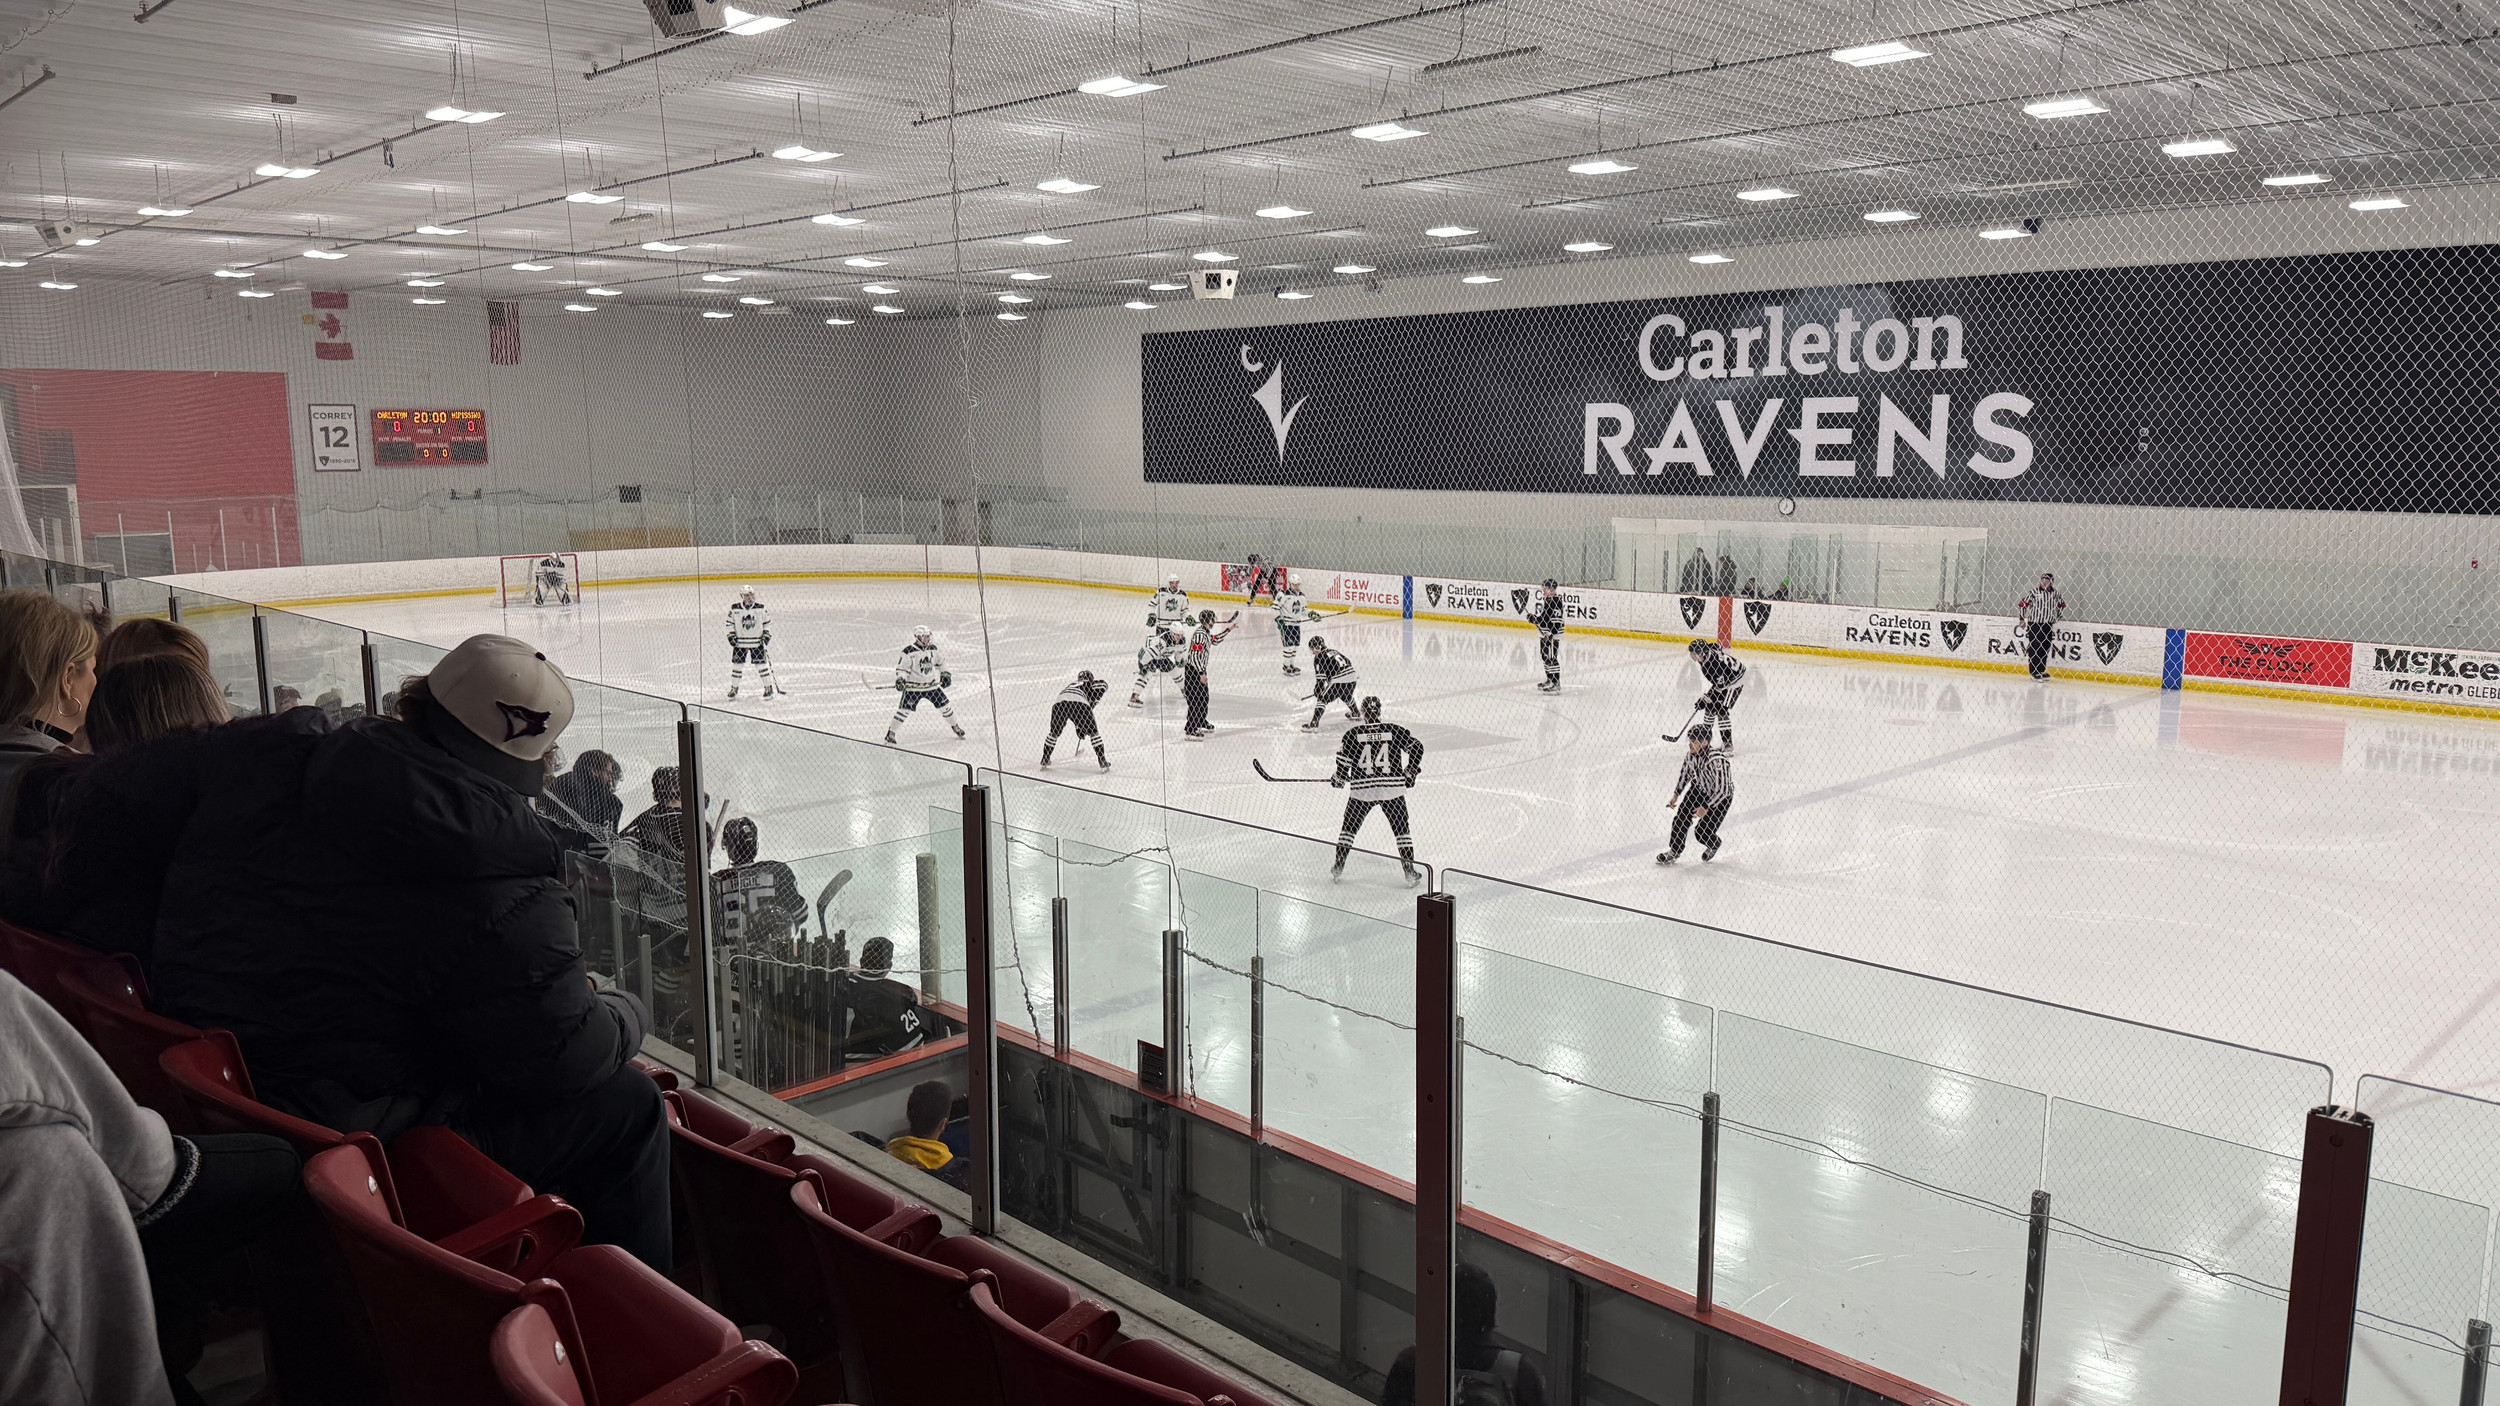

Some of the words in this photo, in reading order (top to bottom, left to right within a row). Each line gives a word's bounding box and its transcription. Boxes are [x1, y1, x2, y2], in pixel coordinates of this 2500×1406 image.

[1639, 306, 1967, 381] Carleton
[312, 412, 353, 420] CORREY
[414, 412, 447, 423] 20:00
[393, 420, 402, 432] 0
[467, 420, 476, 432] 0
[319, 426, 350, 448] 12
[1584, 392, 2035, 480] RAVENS
[1344, 578, 1370, 590] C&W
[1447, 584, 1489, 596] Carleton
[1344, 591, 1399, 605] SERVICES
[1447, 596, 1504, 612] RAVENS
[1535, 603, 1598, 619] RENS
[1868, 613, 1931, 630] Carleton
[1846, 626, 1931, 648] RAVENS
[2219, 656, 2252, 668] THE
[2256, 659, 2315, 674] FLOCK
[2389, 679, 2464, 695] metro
[1357, 742, 1392, 775] 44
[900, 1008, 920, 1033] 29
